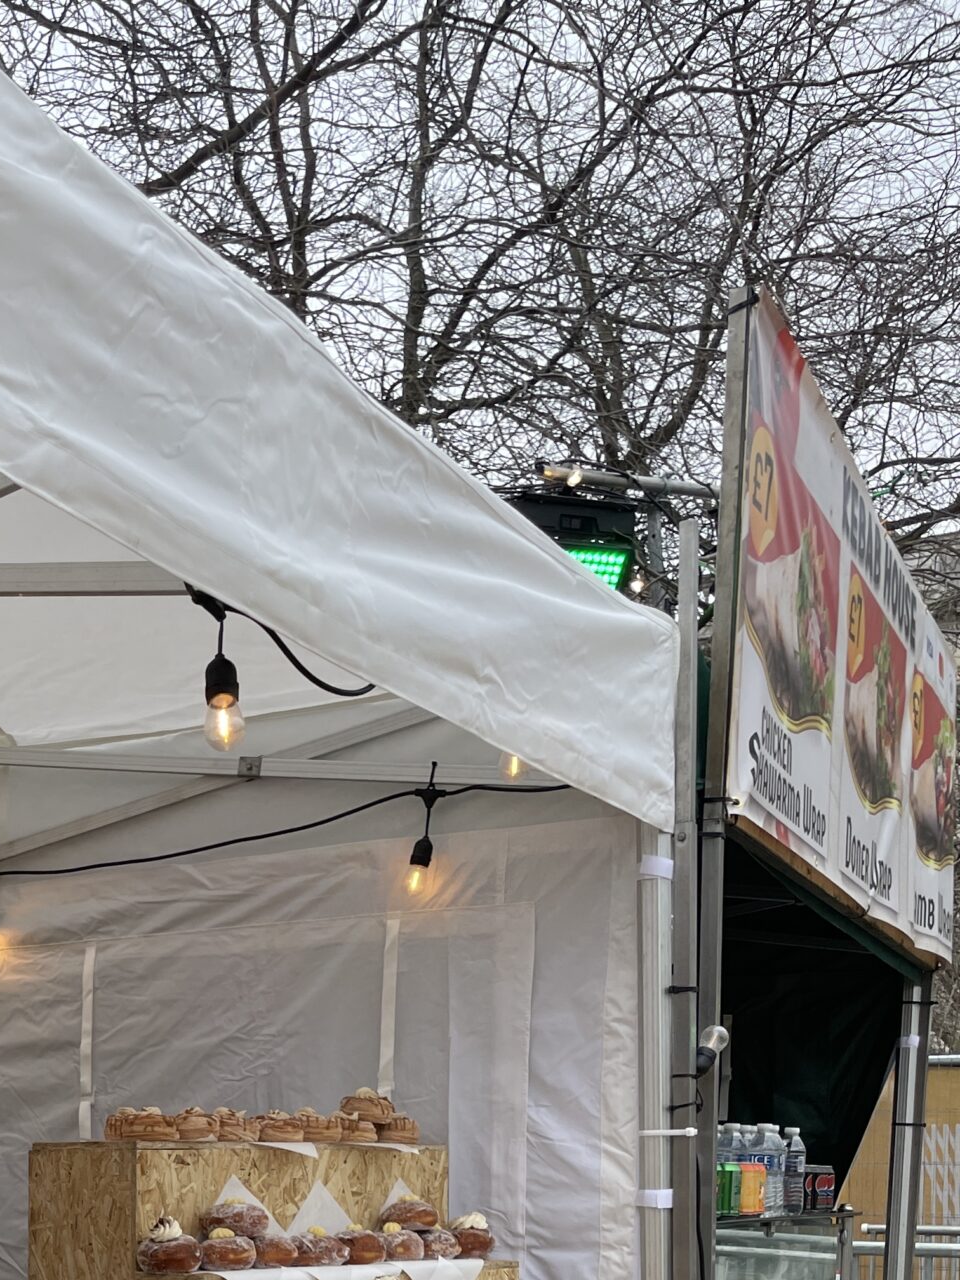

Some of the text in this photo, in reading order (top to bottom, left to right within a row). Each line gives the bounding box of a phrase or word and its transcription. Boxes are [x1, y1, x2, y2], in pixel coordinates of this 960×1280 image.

[751, 452, 774, 522] £7
[842, 464, 917, 652] KEBAB HOUSE
[848, 593, 863, 649] £7
[761, 705, 792, 776] CHICKEN
[748, 731, 826, 847] SHAWARMA WRAP
[845, 816, 870, 886] DONER
